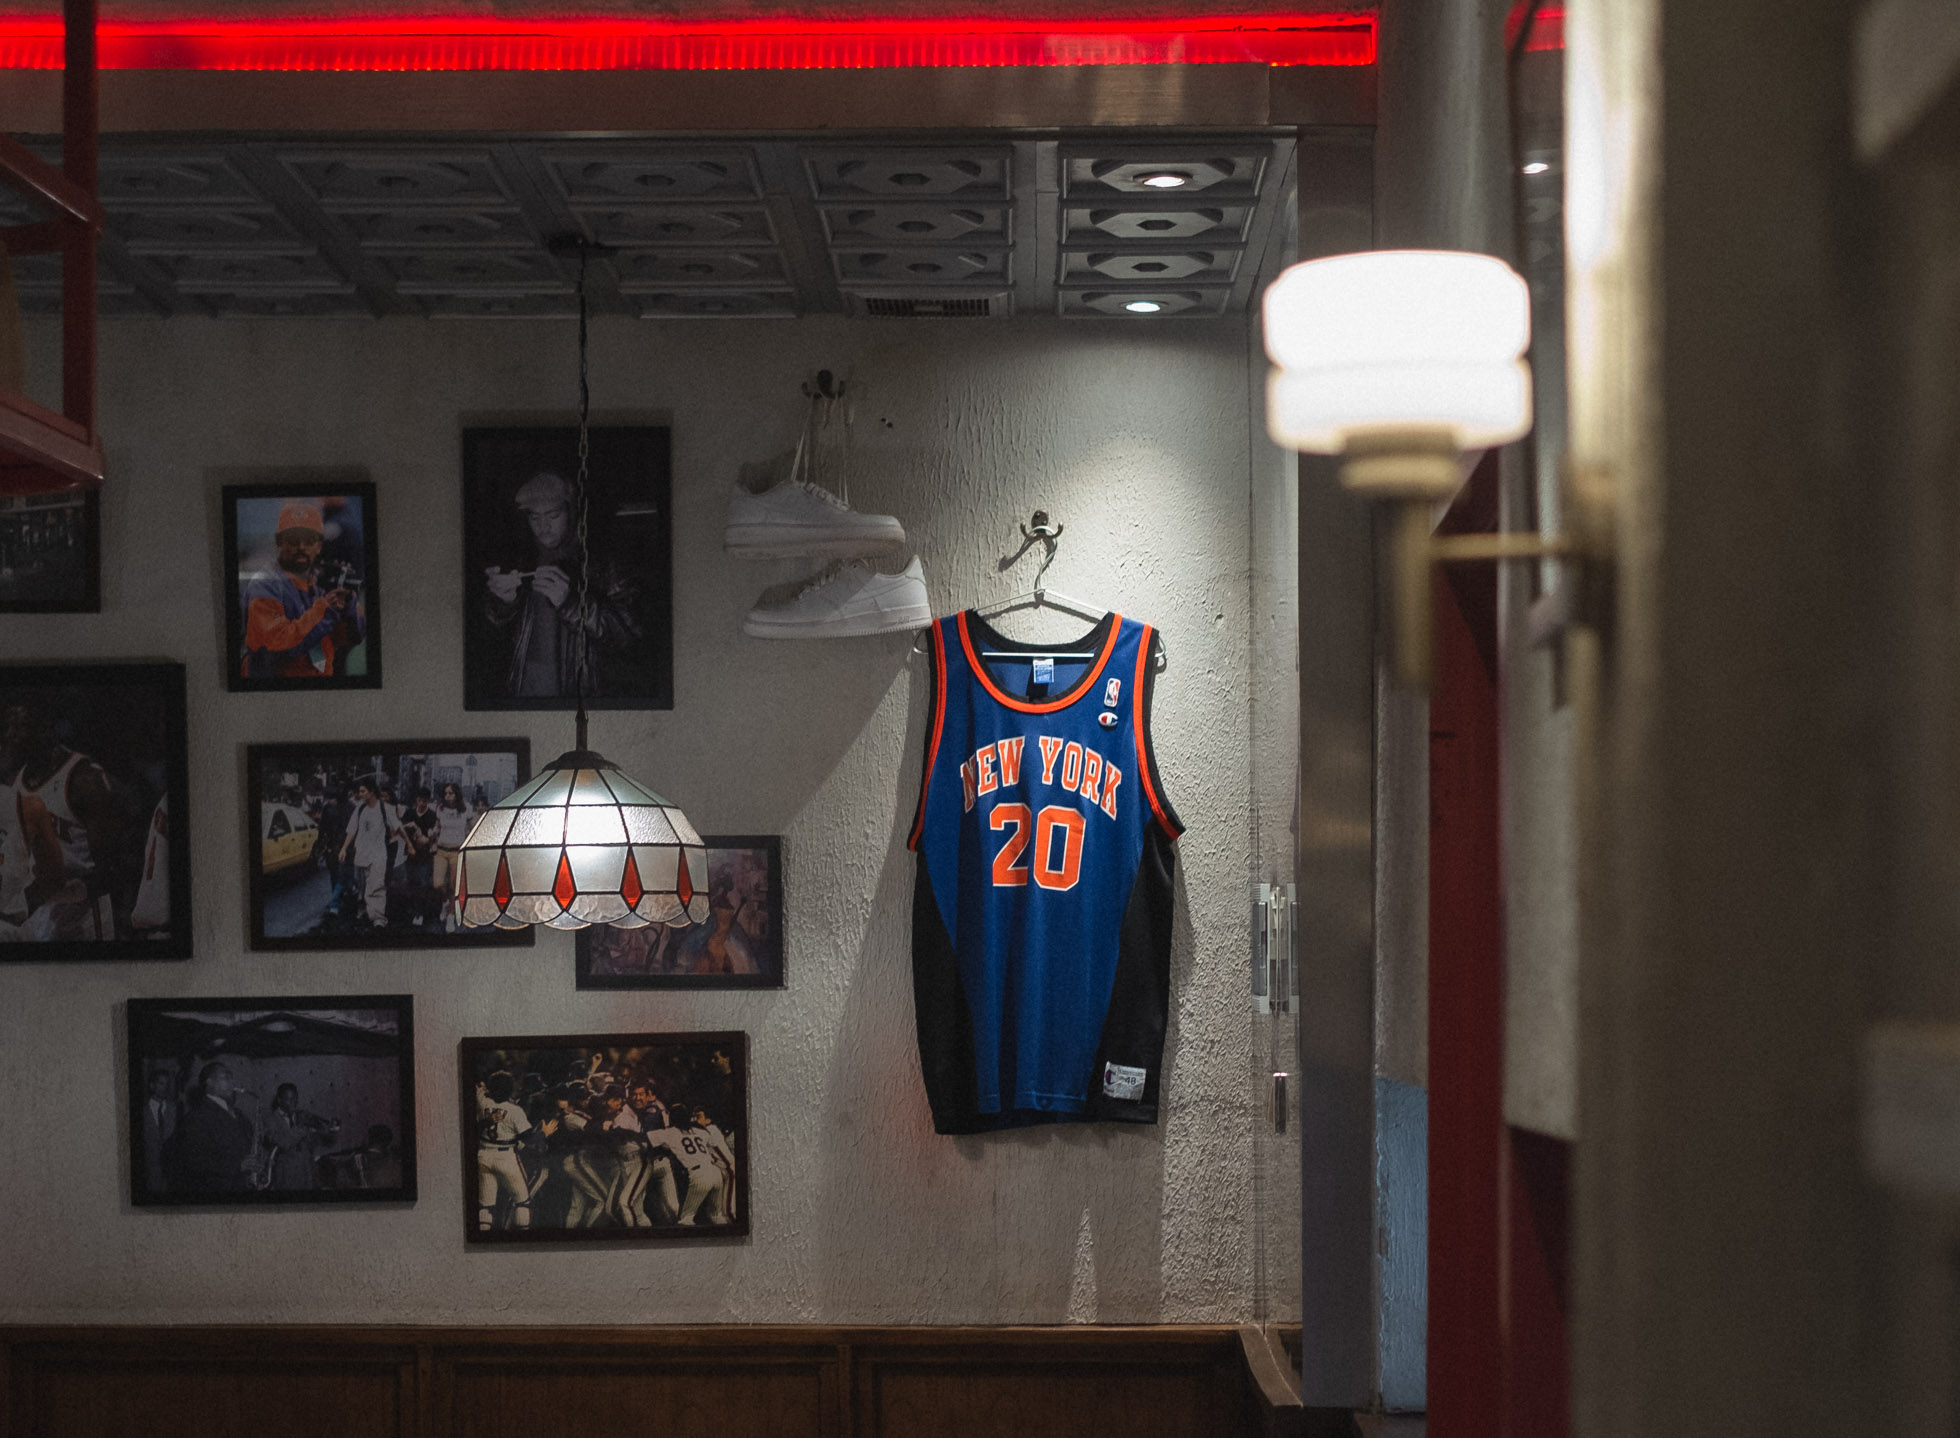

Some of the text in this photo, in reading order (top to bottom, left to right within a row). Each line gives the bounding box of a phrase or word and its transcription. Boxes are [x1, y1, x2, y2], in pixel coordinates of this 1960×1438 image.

[960, 735, 1122, 821] NEW YORK
[989, 802, 1087, 892] 20
[1124, 1076, 1137, 1086] 48
[681, 1137, 707, 1155] 86
